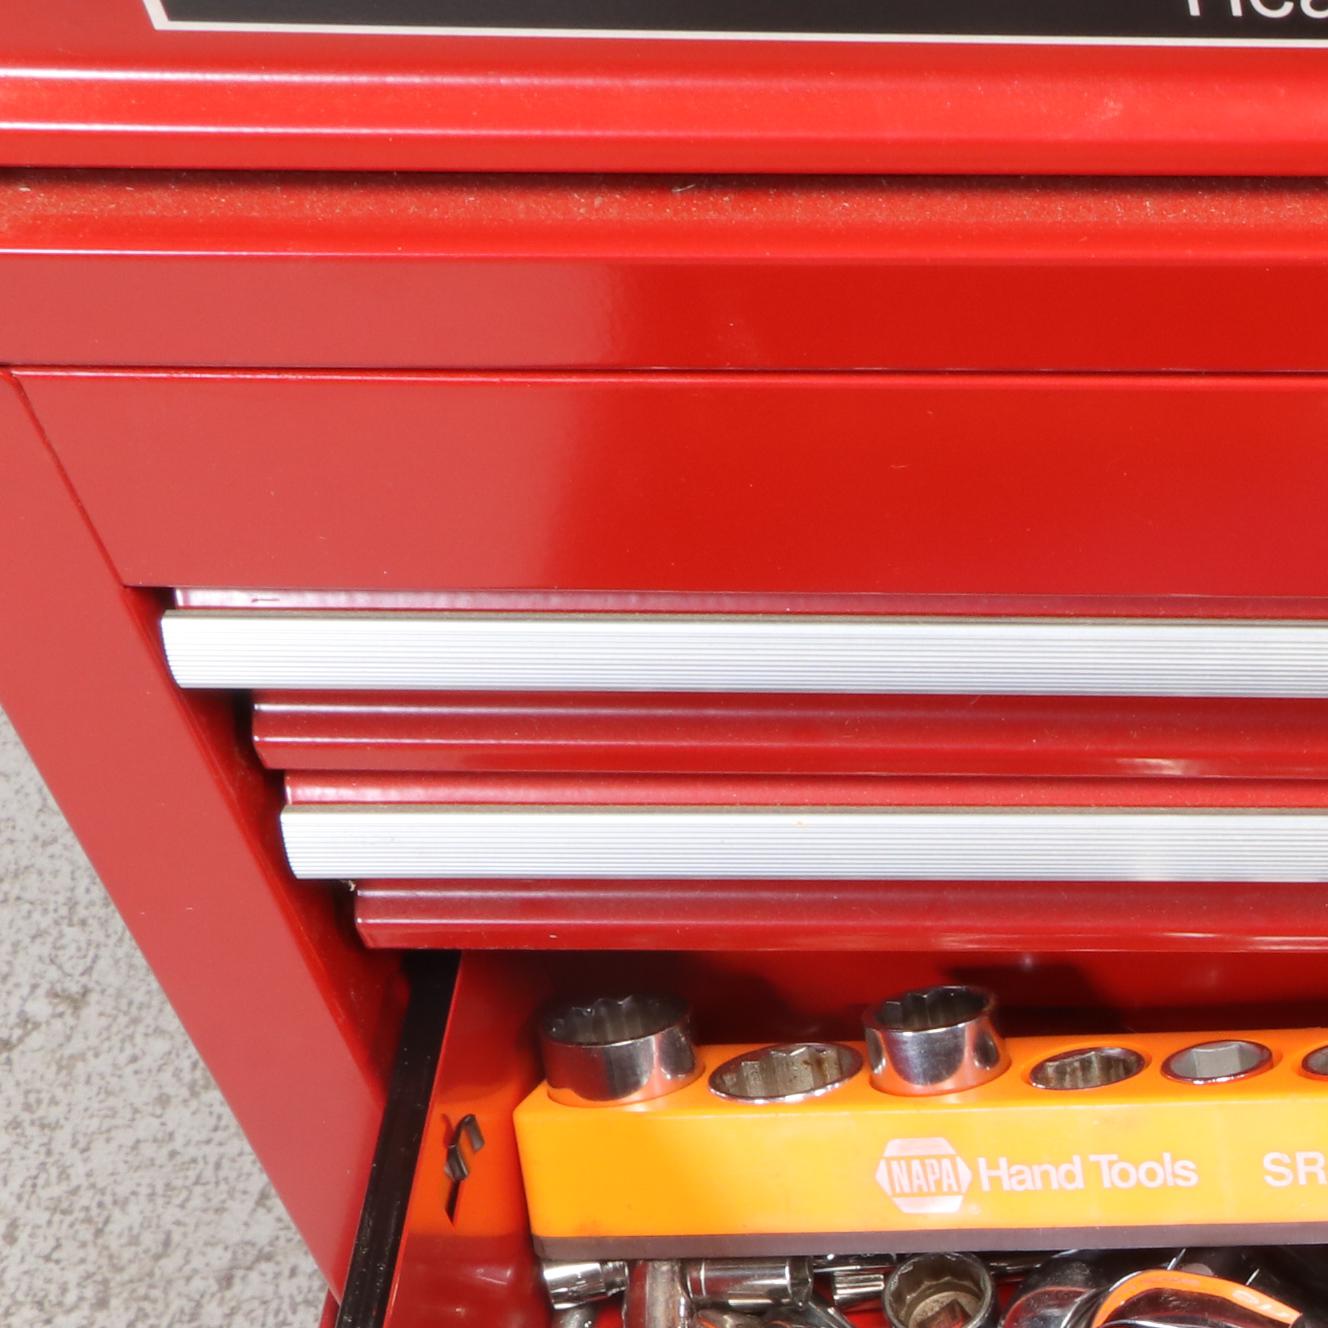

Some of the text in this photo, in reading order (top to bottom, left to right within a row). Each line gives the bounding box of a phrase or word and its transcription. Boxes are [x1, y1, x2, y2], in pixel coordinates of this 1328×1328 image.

[890, 1159, 959, 1195] NAPA
[977, 1155, 1085, 1192] Hand
[1088, 1151, 1200, 1190] Tools
